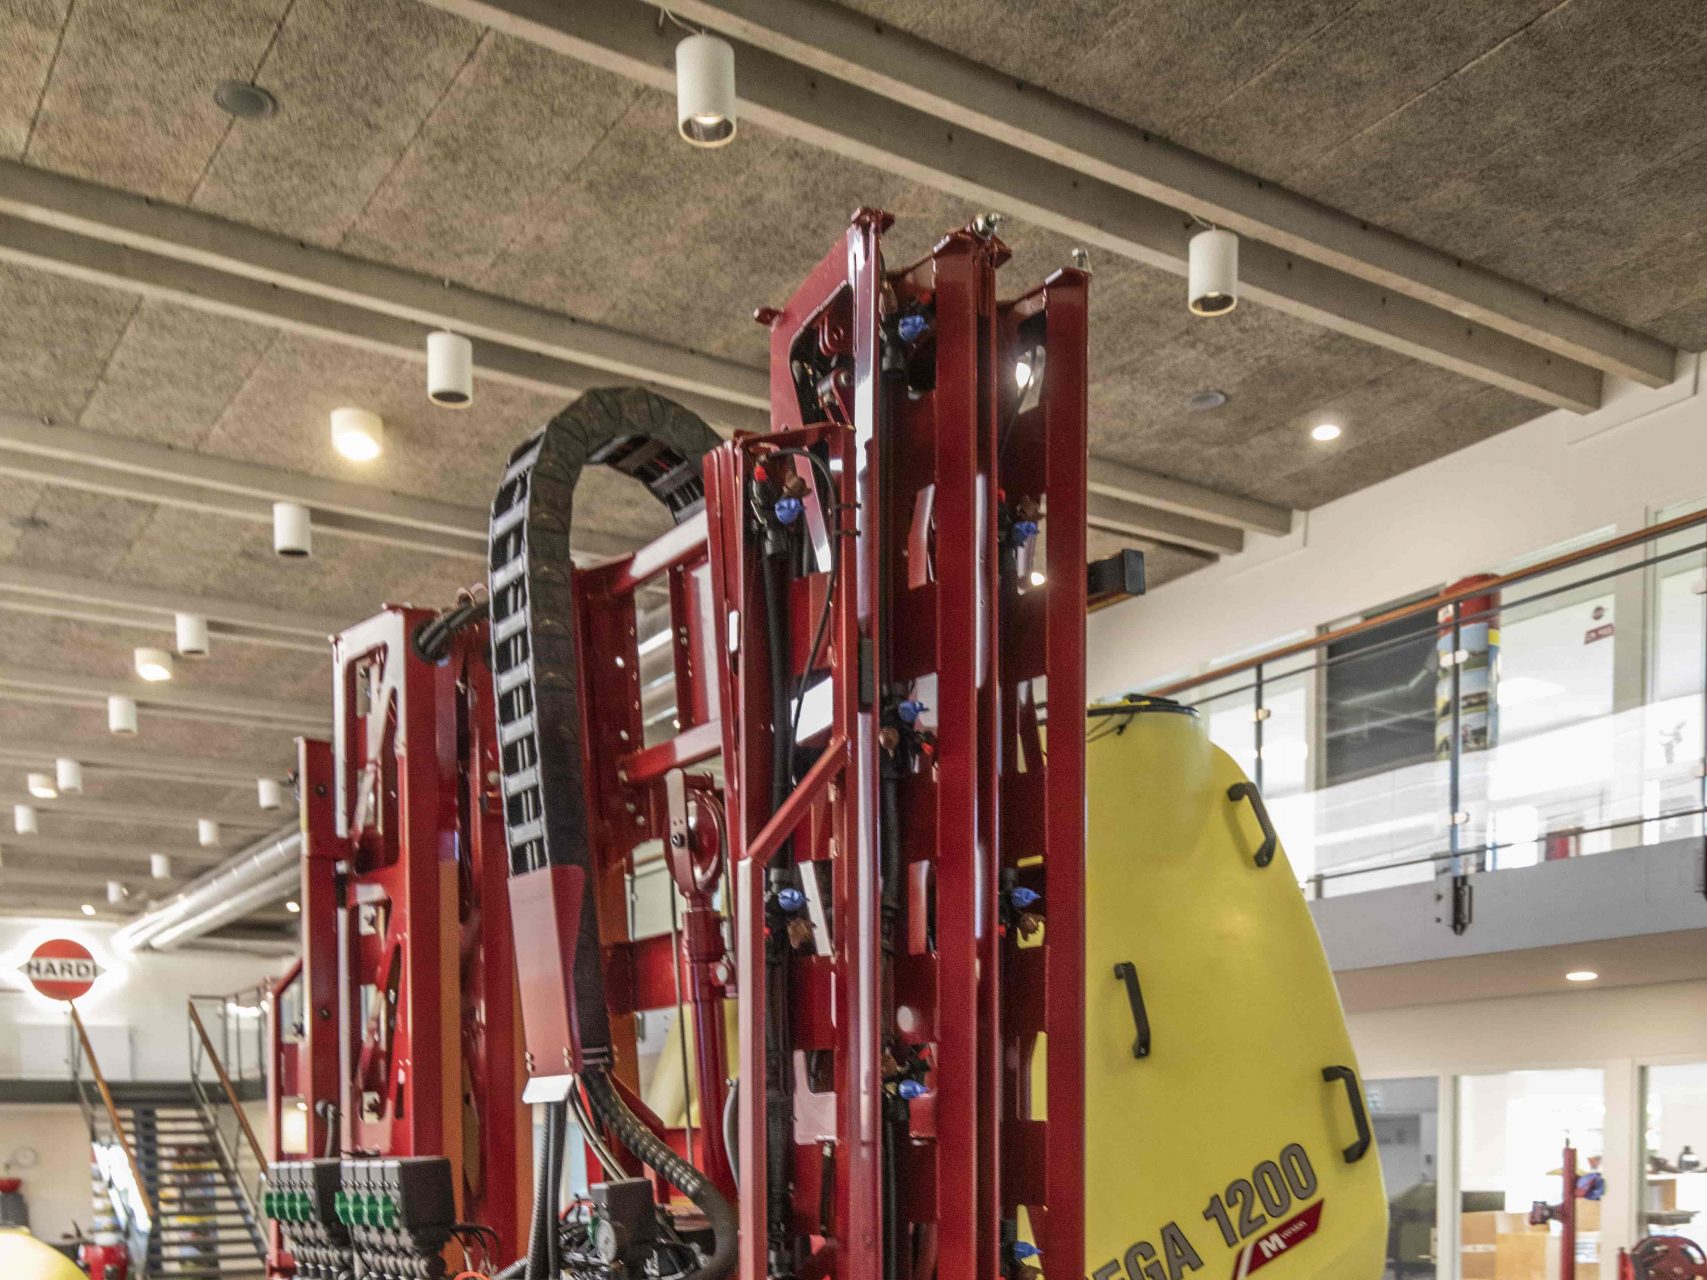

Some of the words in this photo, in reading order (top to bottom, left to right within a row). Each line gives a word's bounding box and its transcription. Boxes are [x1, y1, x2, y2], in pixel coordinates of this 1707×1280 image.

[26, 960, 97, 978] HARDI
[1202, 1142, 1318, 1249] 1200
[1258, 1232, 1287, 1259] M
